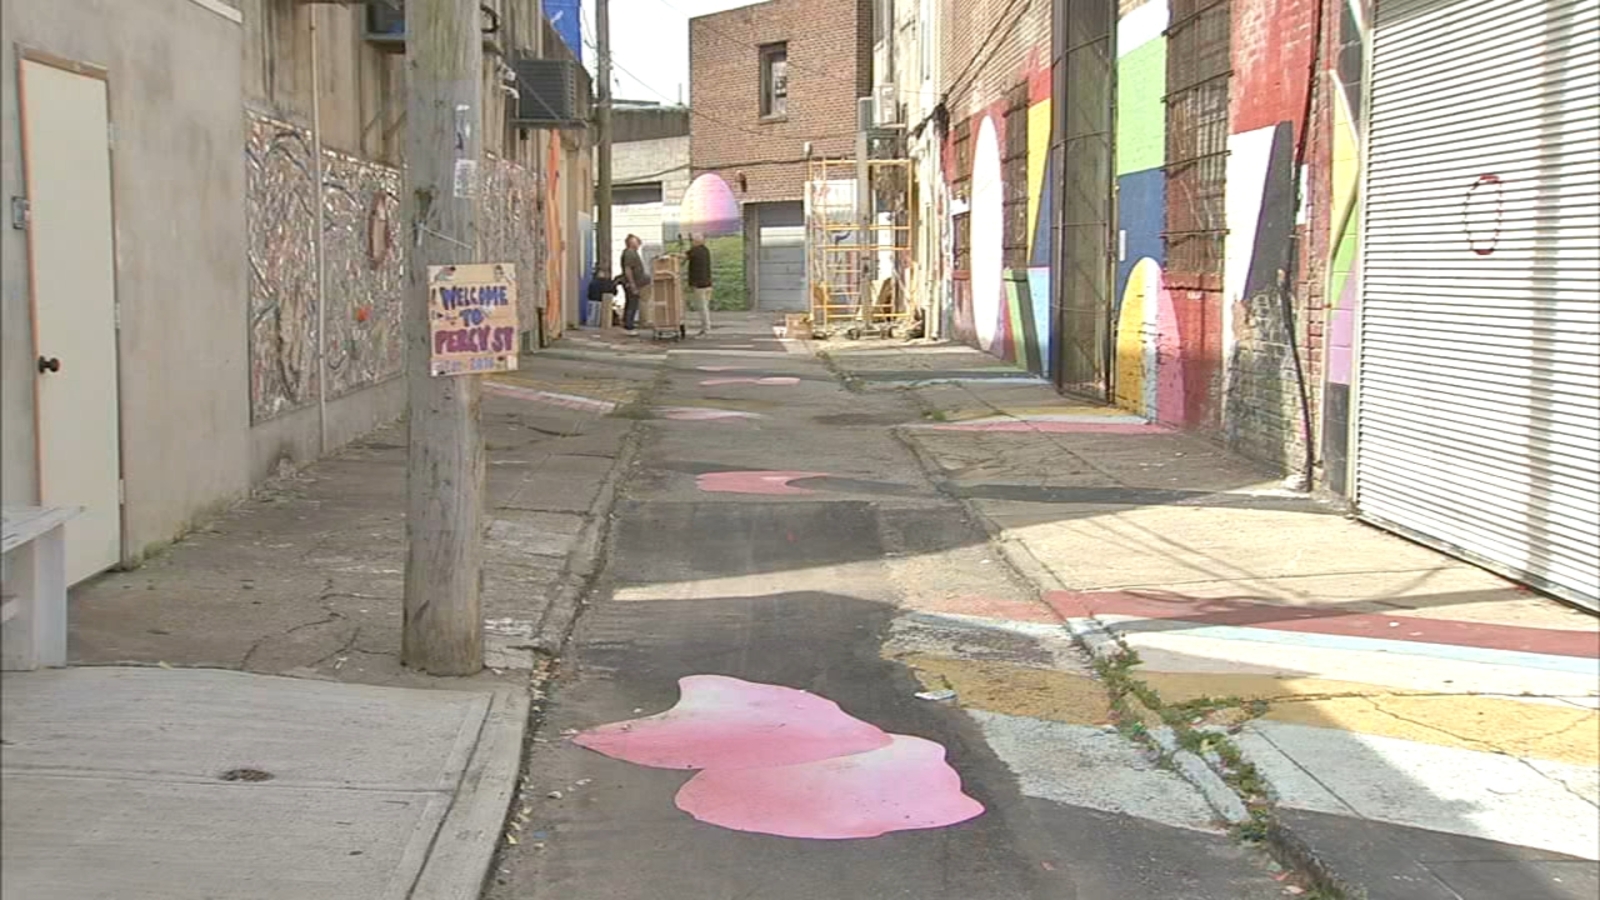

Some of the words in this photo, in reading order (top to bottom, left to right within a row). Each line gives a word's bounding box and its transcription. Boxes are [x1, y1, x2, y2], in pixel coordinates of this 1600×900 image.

[439, 285, 508, 310] WELCOME
[460, 307, 482, 327] TO
[434, 325, 490, 355] PERCY
[491, 326, 514, 353] ST
